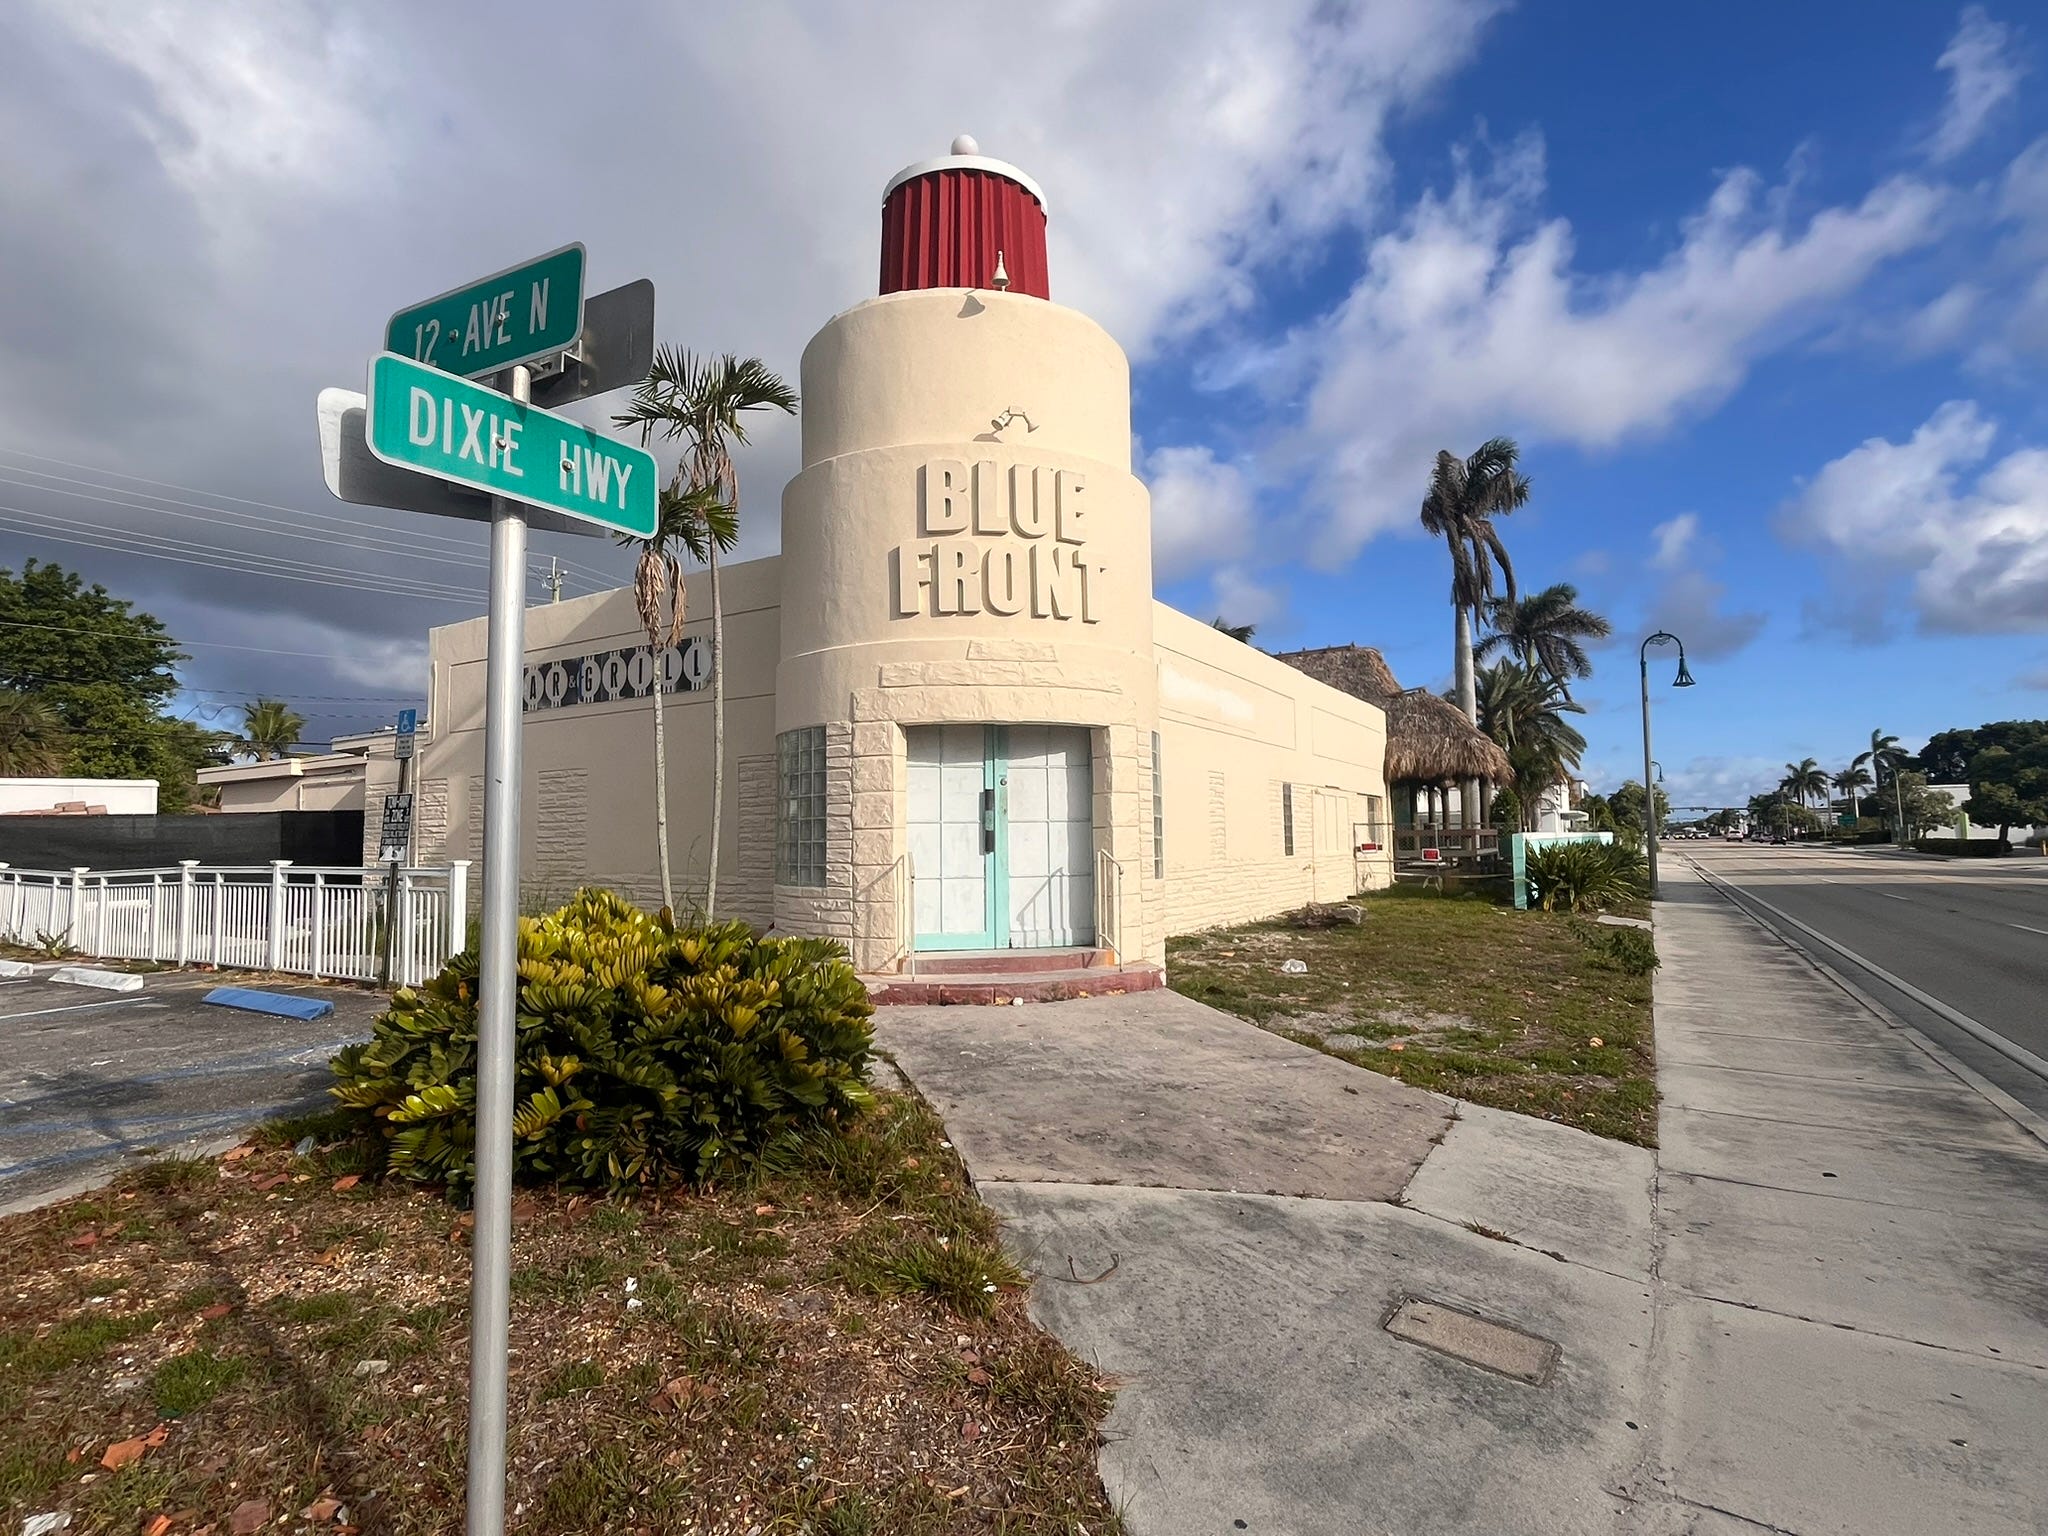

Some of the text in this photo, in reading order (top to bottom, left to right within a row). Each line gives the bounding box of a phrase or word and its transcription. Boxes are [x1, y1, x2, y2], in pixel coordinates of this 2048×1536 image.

[414, 277, 549, 366] 12 AVE N
[409, 386, 633, 509] DIXIE HWY
[916, 459, 1086, 545] BLUE
[888, 541, 1108, 624] FRONT
[529, 653, 702, 700] AR & GRILL
